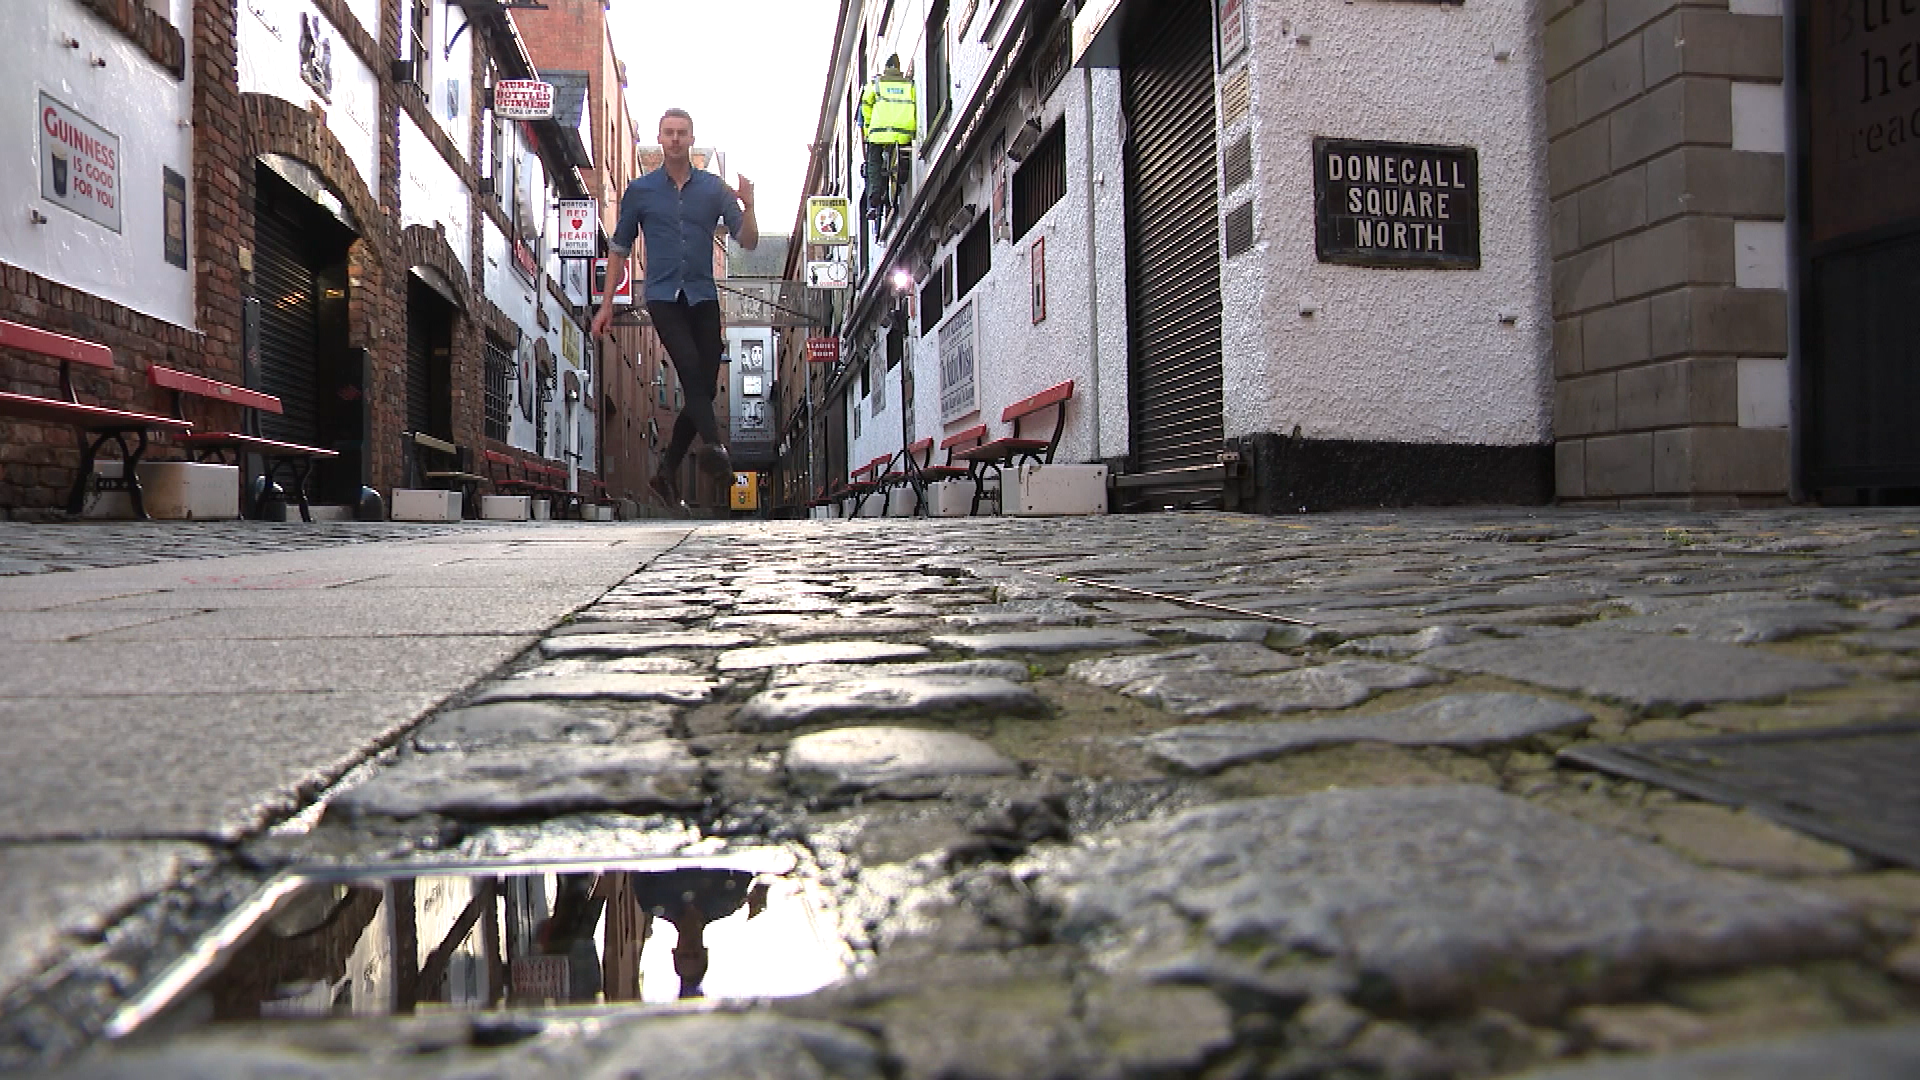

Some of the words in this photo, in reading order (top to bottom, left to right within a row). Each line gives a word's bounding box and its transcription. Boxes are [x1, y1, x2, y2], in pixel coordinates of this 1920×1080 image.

[495, 99, 550, 108] GUINNESS
[496, 90, 551, 100] BOTTLED
[43, 105, 115, 171] GUINNESS
[73, 155, 82, 173] IS
[85, 163, 113, 189] GOOD
[73, 175, 93, 199] FOR
[96, 188, 114, 208] YOU
[1348, 187, 1449, 219] SQUARE
[566, 209, 588, 218] RED
[560, 231, 594, 240] HEART
[1357, 219, 1443, 251] NORTH
